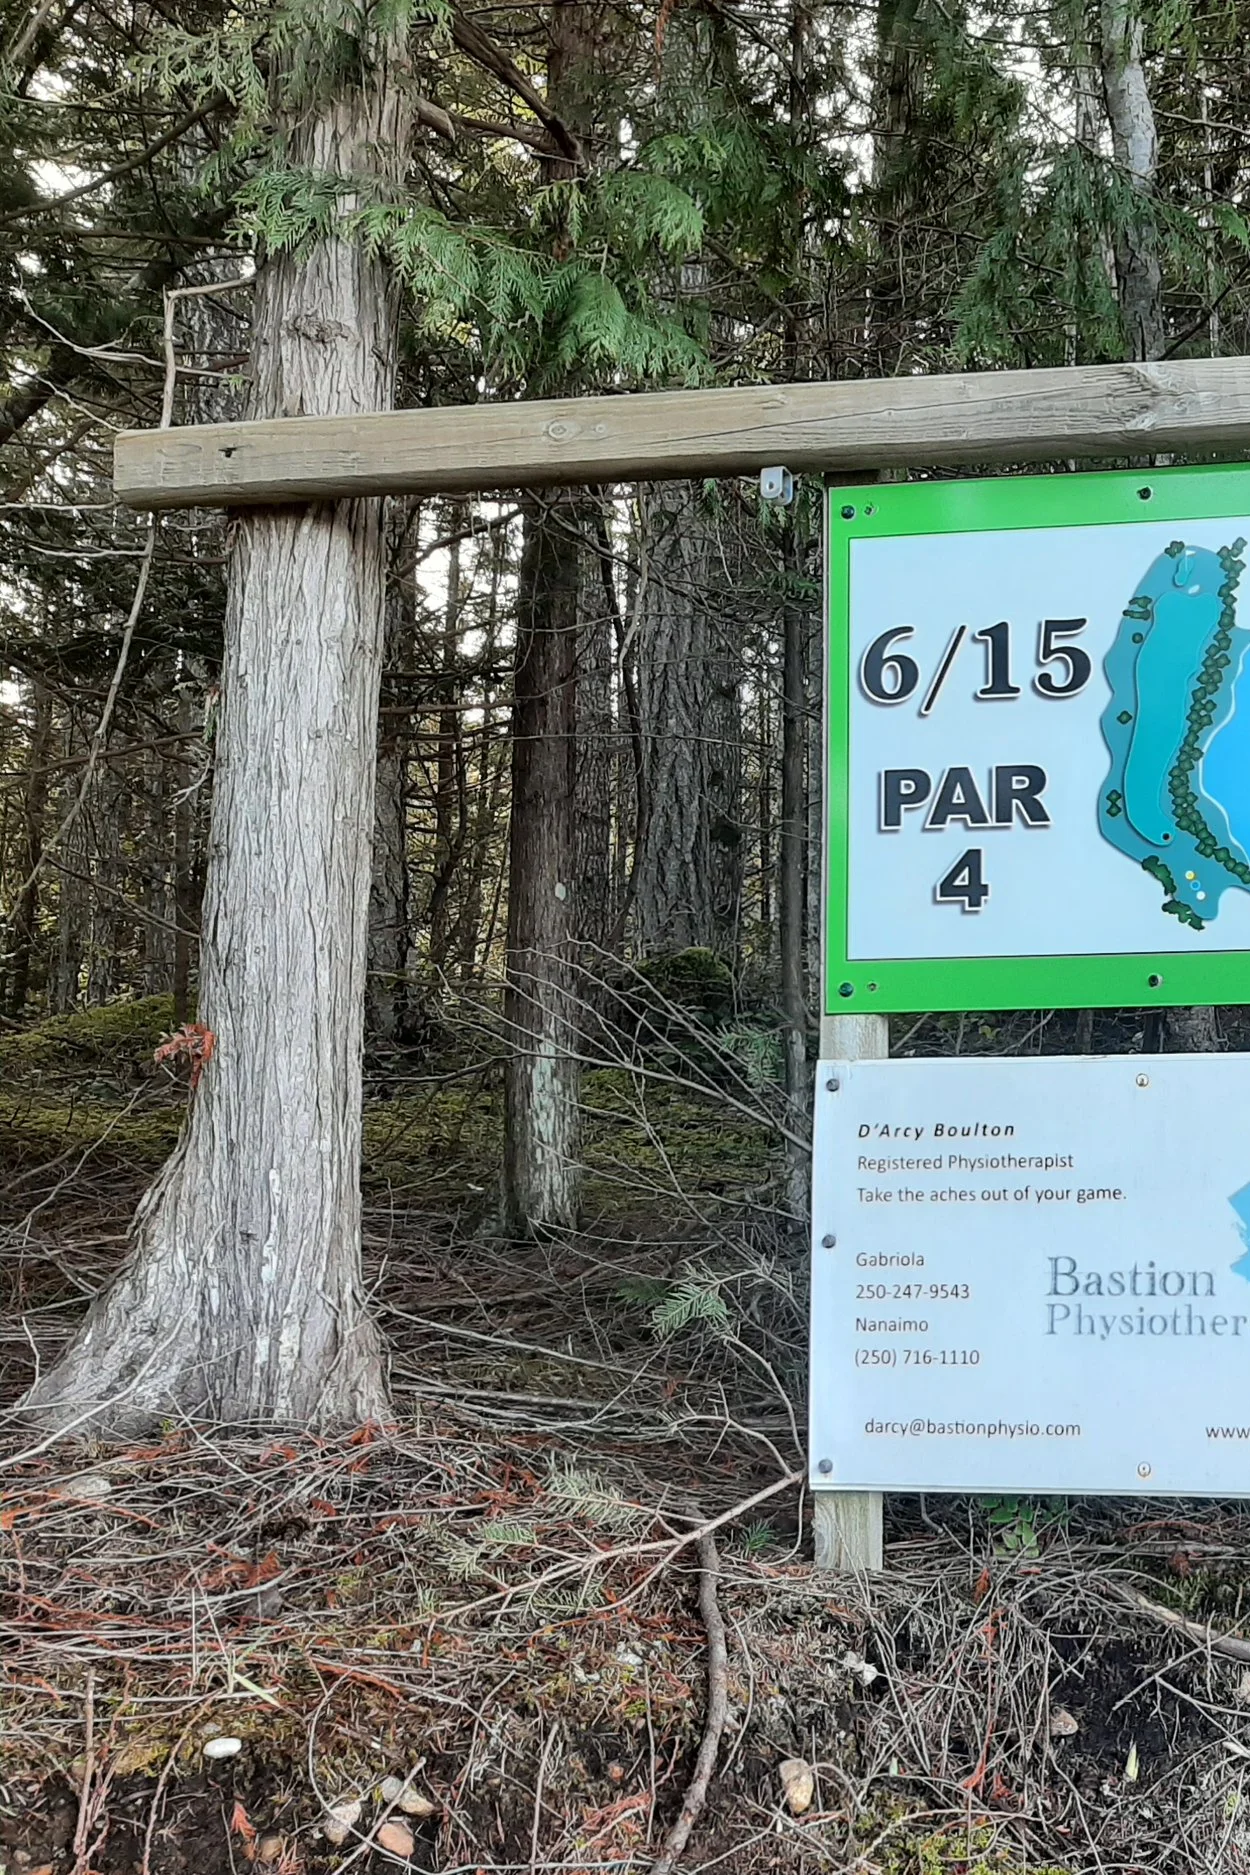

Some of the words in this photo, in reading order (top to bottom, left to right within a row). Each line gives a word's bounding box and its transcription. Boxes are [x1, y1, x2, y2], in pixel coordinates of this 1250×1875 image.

[860, 616, 1092, 715] 6/15
[881, 764, 1051, 830] PAR
[936, 849, 989, 911] 4
[934, 1122, 1016, 1138] Boulton
[858, 1154, 943, 1173] Registered
[948, 1153, 1074, 1172] Physiotherapist
[857, 1187, 893, 1202] Take
[898, 1187, 925, 1202] the
[930, 1187, 976, 1201] aches
[981, 1188, 1008, 1201] out
[1013, 1186, 1031, 1201] of
[1035, 1190, 1072, 1204] your
[1076, 1188, 1126, 1203] game.
[856, 1251, 925, 1267] Gabriola
[1046, 1256, 1216, 1298] Bastion
[855, 1283, 970, 1300] 250-247-9543
[855, 1317, 929, 1332] Nanaimo
[855, 1349, 897, 1367] (250)
[902, 1349, 980, 1366] 716-1110
[865, 1419, 1081, 1438] darcy@bastionphysio.com
